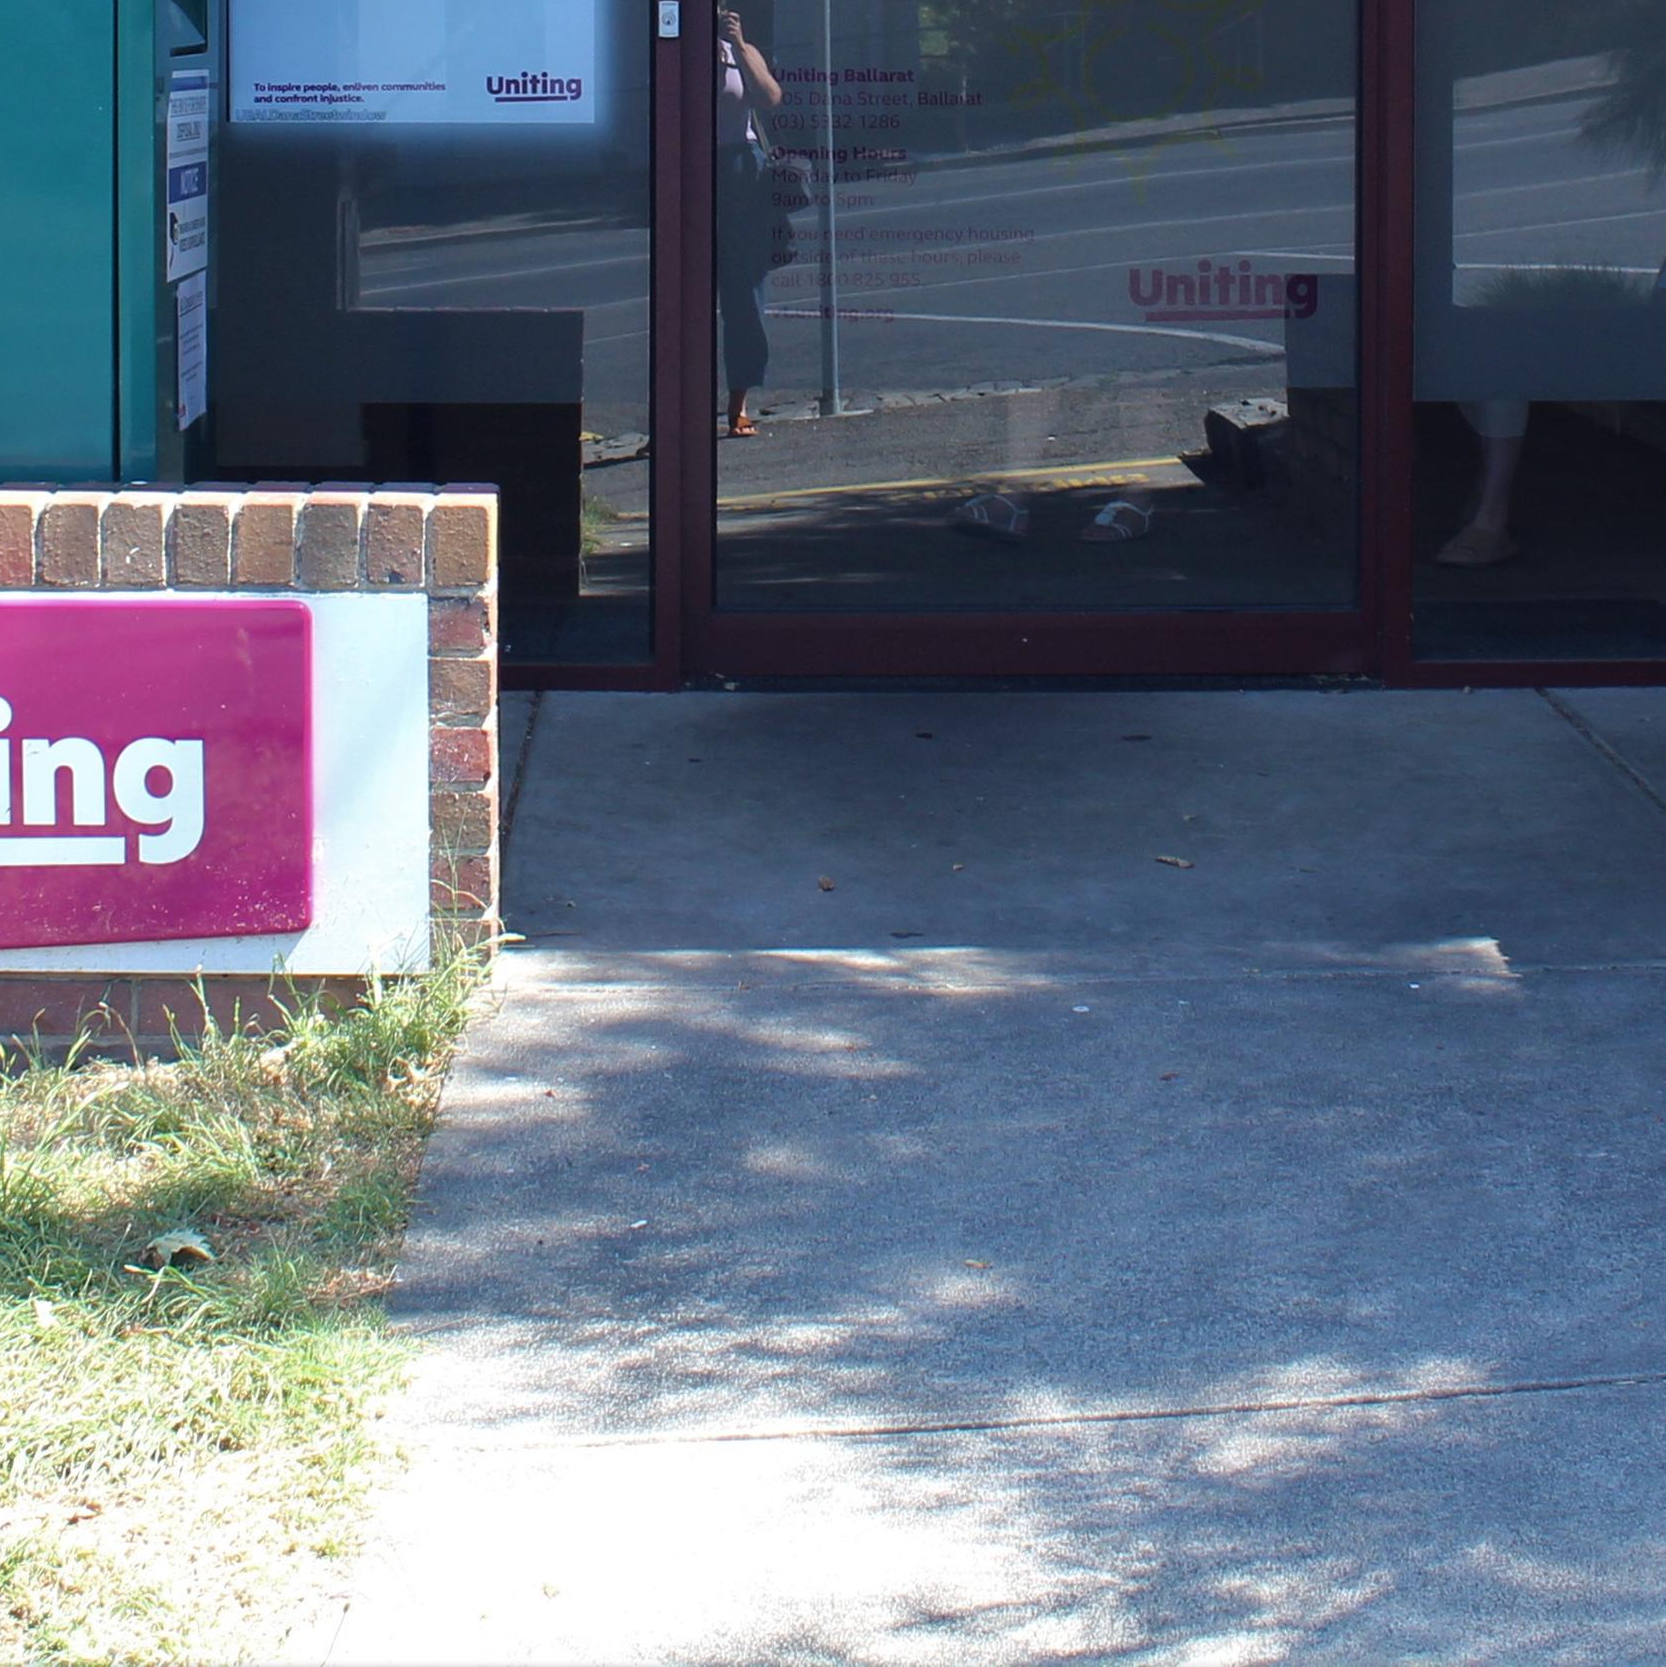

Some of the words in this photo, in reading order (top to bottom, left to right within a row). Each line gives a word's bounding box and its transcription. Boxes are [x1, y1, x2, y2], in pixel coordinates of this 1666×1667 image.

[772, 67, 839, 85] Uniting
[844, 68, 914, 84] Ballarat
[254, 83, 266, 92] To
[267, 83, 301, 94] inspire
[303, 83, 340, 94] people,
[343, 82, 378, 92] enliven
[381, 82, 445, 92] communities
[486, 70, 582, 101] Uniting
[254, 94, 272, 103] and
[275, 93, 318, 103] confront
[320, 93, 364, 104] injustice.
[776, 91, 803, 106] 05
[809, 91, 852, 106] Dana
[857, 91, 914, 107] Street,
[918, 91, 984, 106] Ballarat
[772, 113, 805, 131] (03)
[860, 114, 901, 129] 1286
[772, 146, 847, 164] Opening
[853, 146, 908, 161] Hours
[772, 169, 838, 185] Monday
[844, 169, 861, 182] to
[866, 169, 917, 185] Friday
[772, 192, 808, 207] 9am
[814, 193, 831, 207] to
[836, 193, 875, 208] 5pm
[772, 227, 784, 240] If
[788, 230, 818, 243] you
[823, 226, 865, 240] need
[869, 229, 964, 244] emergency
[968, 226, 1035, 245] housing
[771, 249, 833, 264] outside
[843, 248, 857, 263] of
[861, 249, 906, 263] these
[967, 248, 1022, 265] please
[771, 272, 799, 287] call
[808, 272, 849, 287] 1800
[853, 272, 884, 287] 825
[1129, 258, 1319, 319] Uniting
